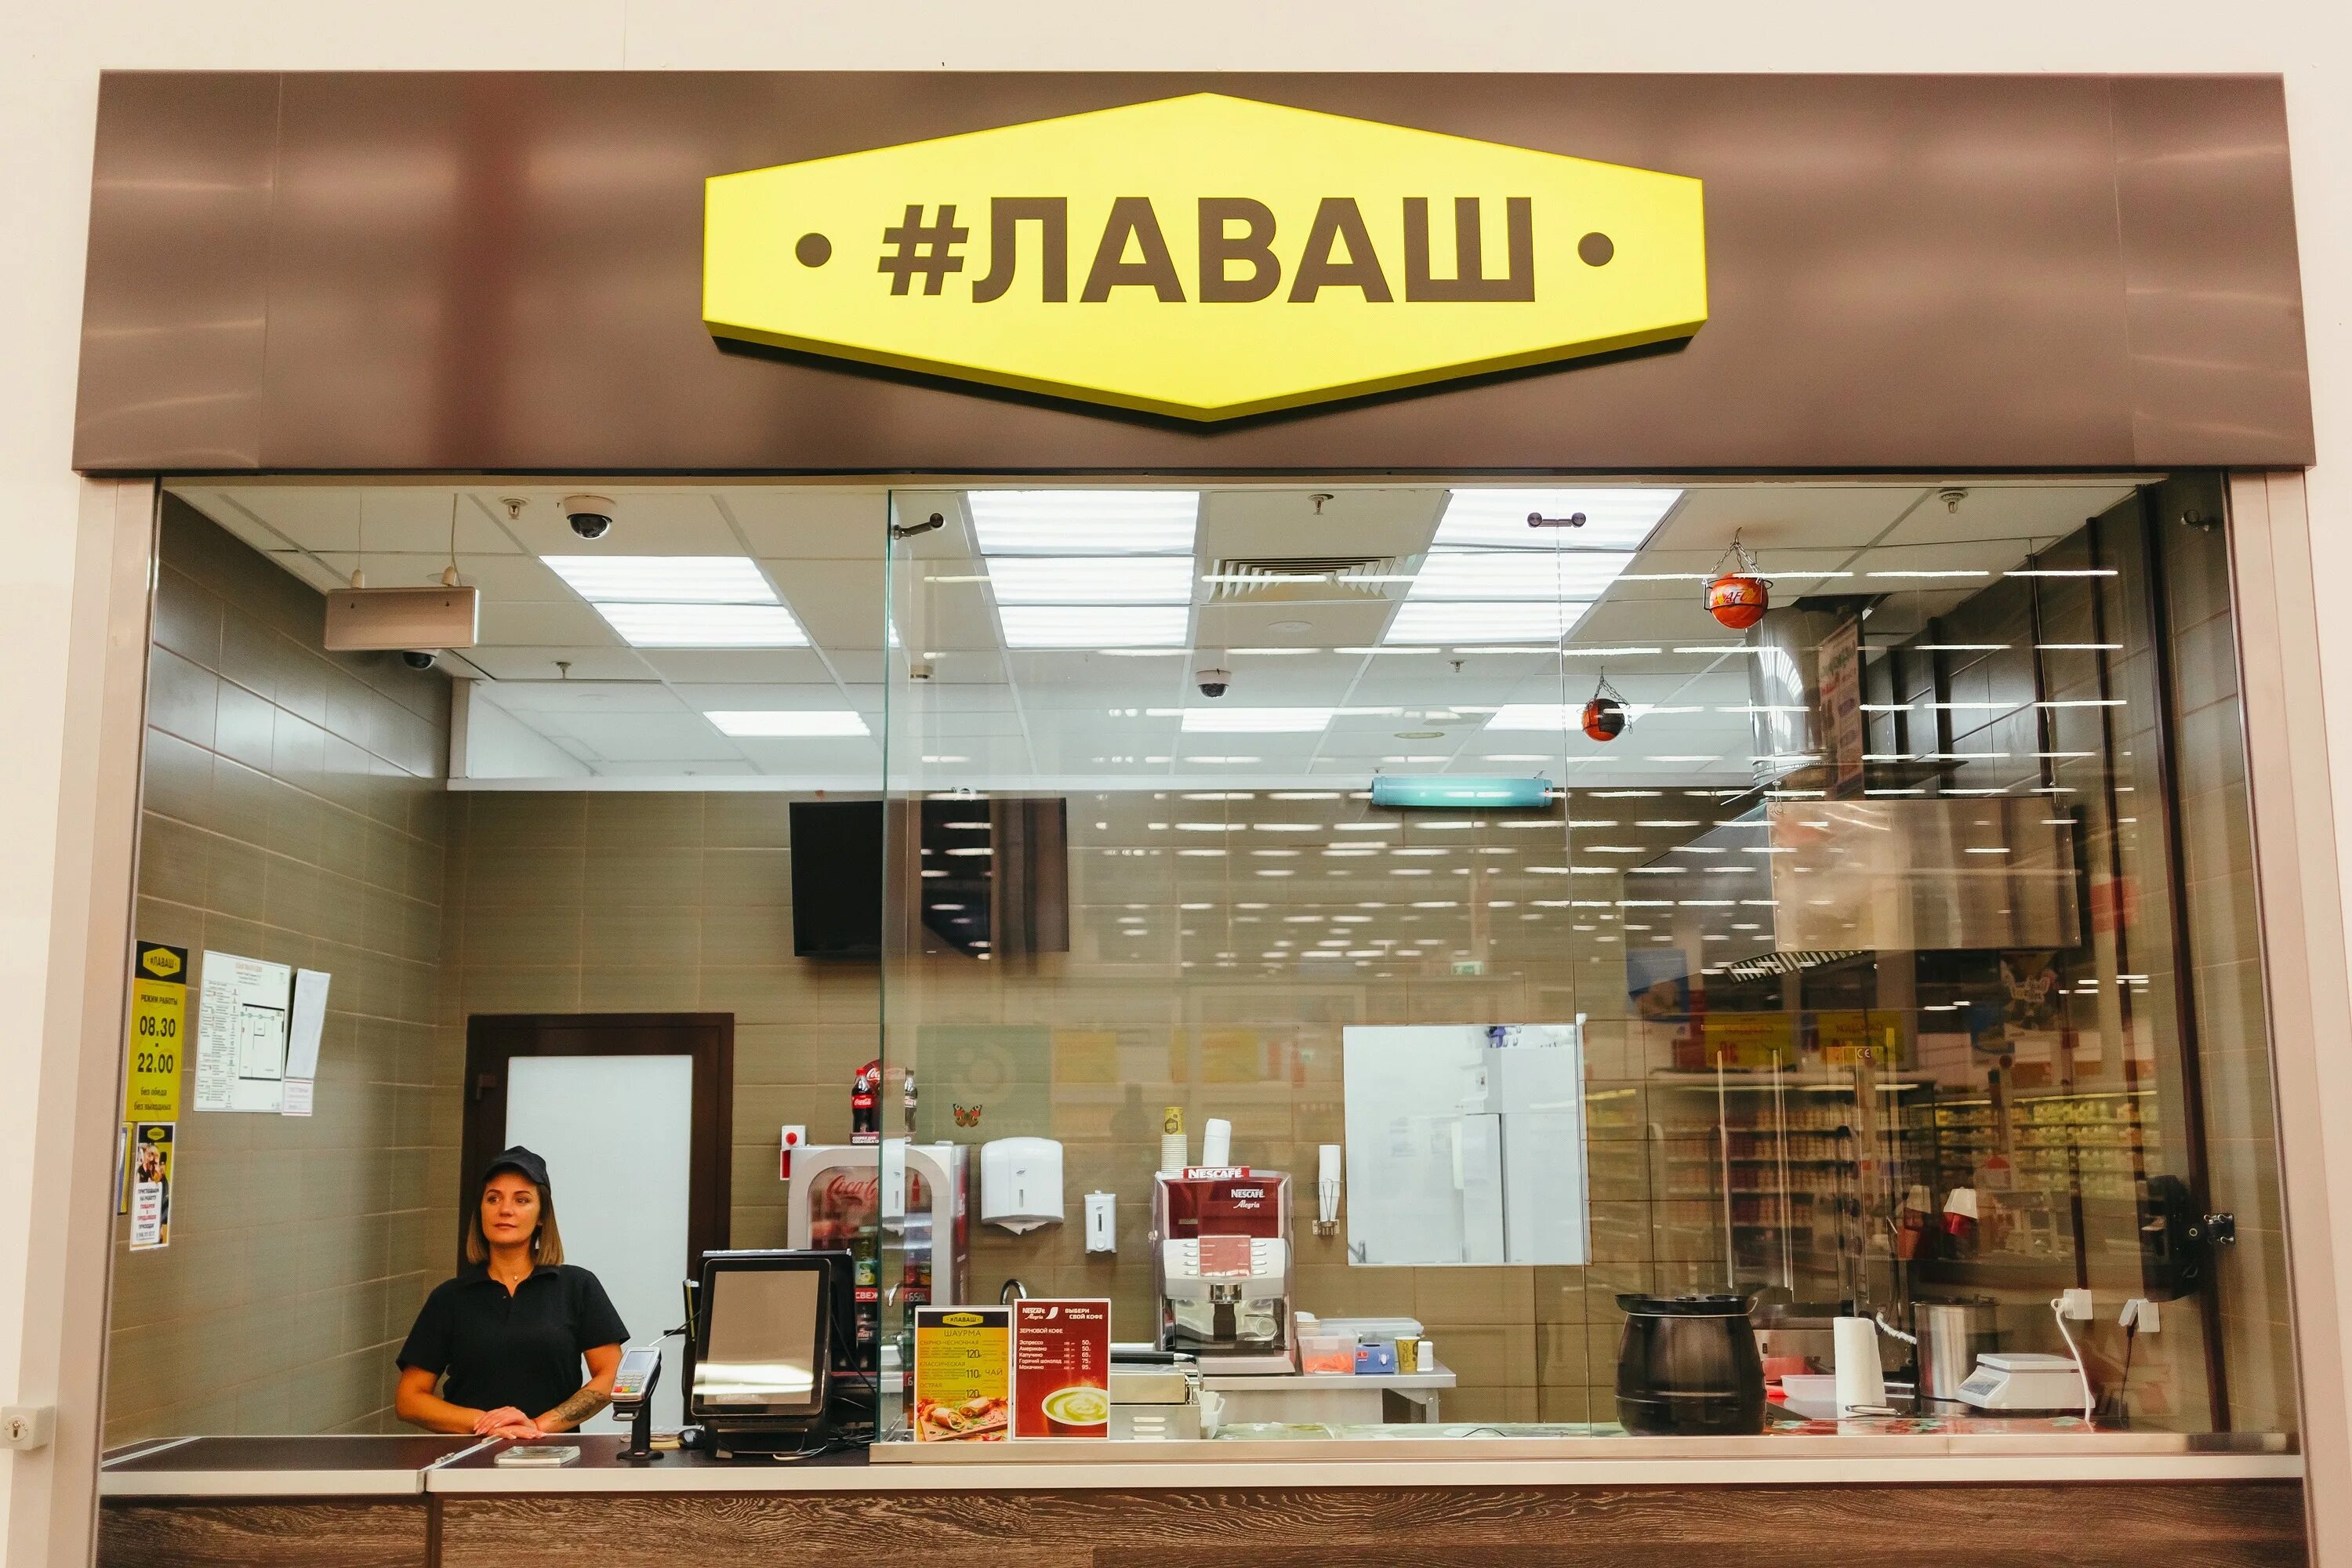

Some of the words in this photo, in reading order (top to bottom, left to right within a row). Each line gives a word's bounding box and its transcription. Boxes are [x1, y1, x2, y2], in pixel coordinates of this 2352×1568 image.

[877, 197, 1536, 303] #ЛАВАШ
[150, 956, 174, 968] #ЛАВАШ
[140, 993, 158, 1004] РЕЖИМ
[159, 996, 178, 1005] РАБОТЫ
[140, 1015, 176, 1037] 08.30
[137, 1052, 174, 1073] 22.00
[1188, 1167, 1243, 1179] NESCAFÉ
[826, 1175, 878, 1203] Coca-C
[1231, 1189, 1265, 1198] NESCAFÉ
[1233, 1200, 1260, 1210] Alegria
[985, 1367, 1003, 1376] ЧАЙ
